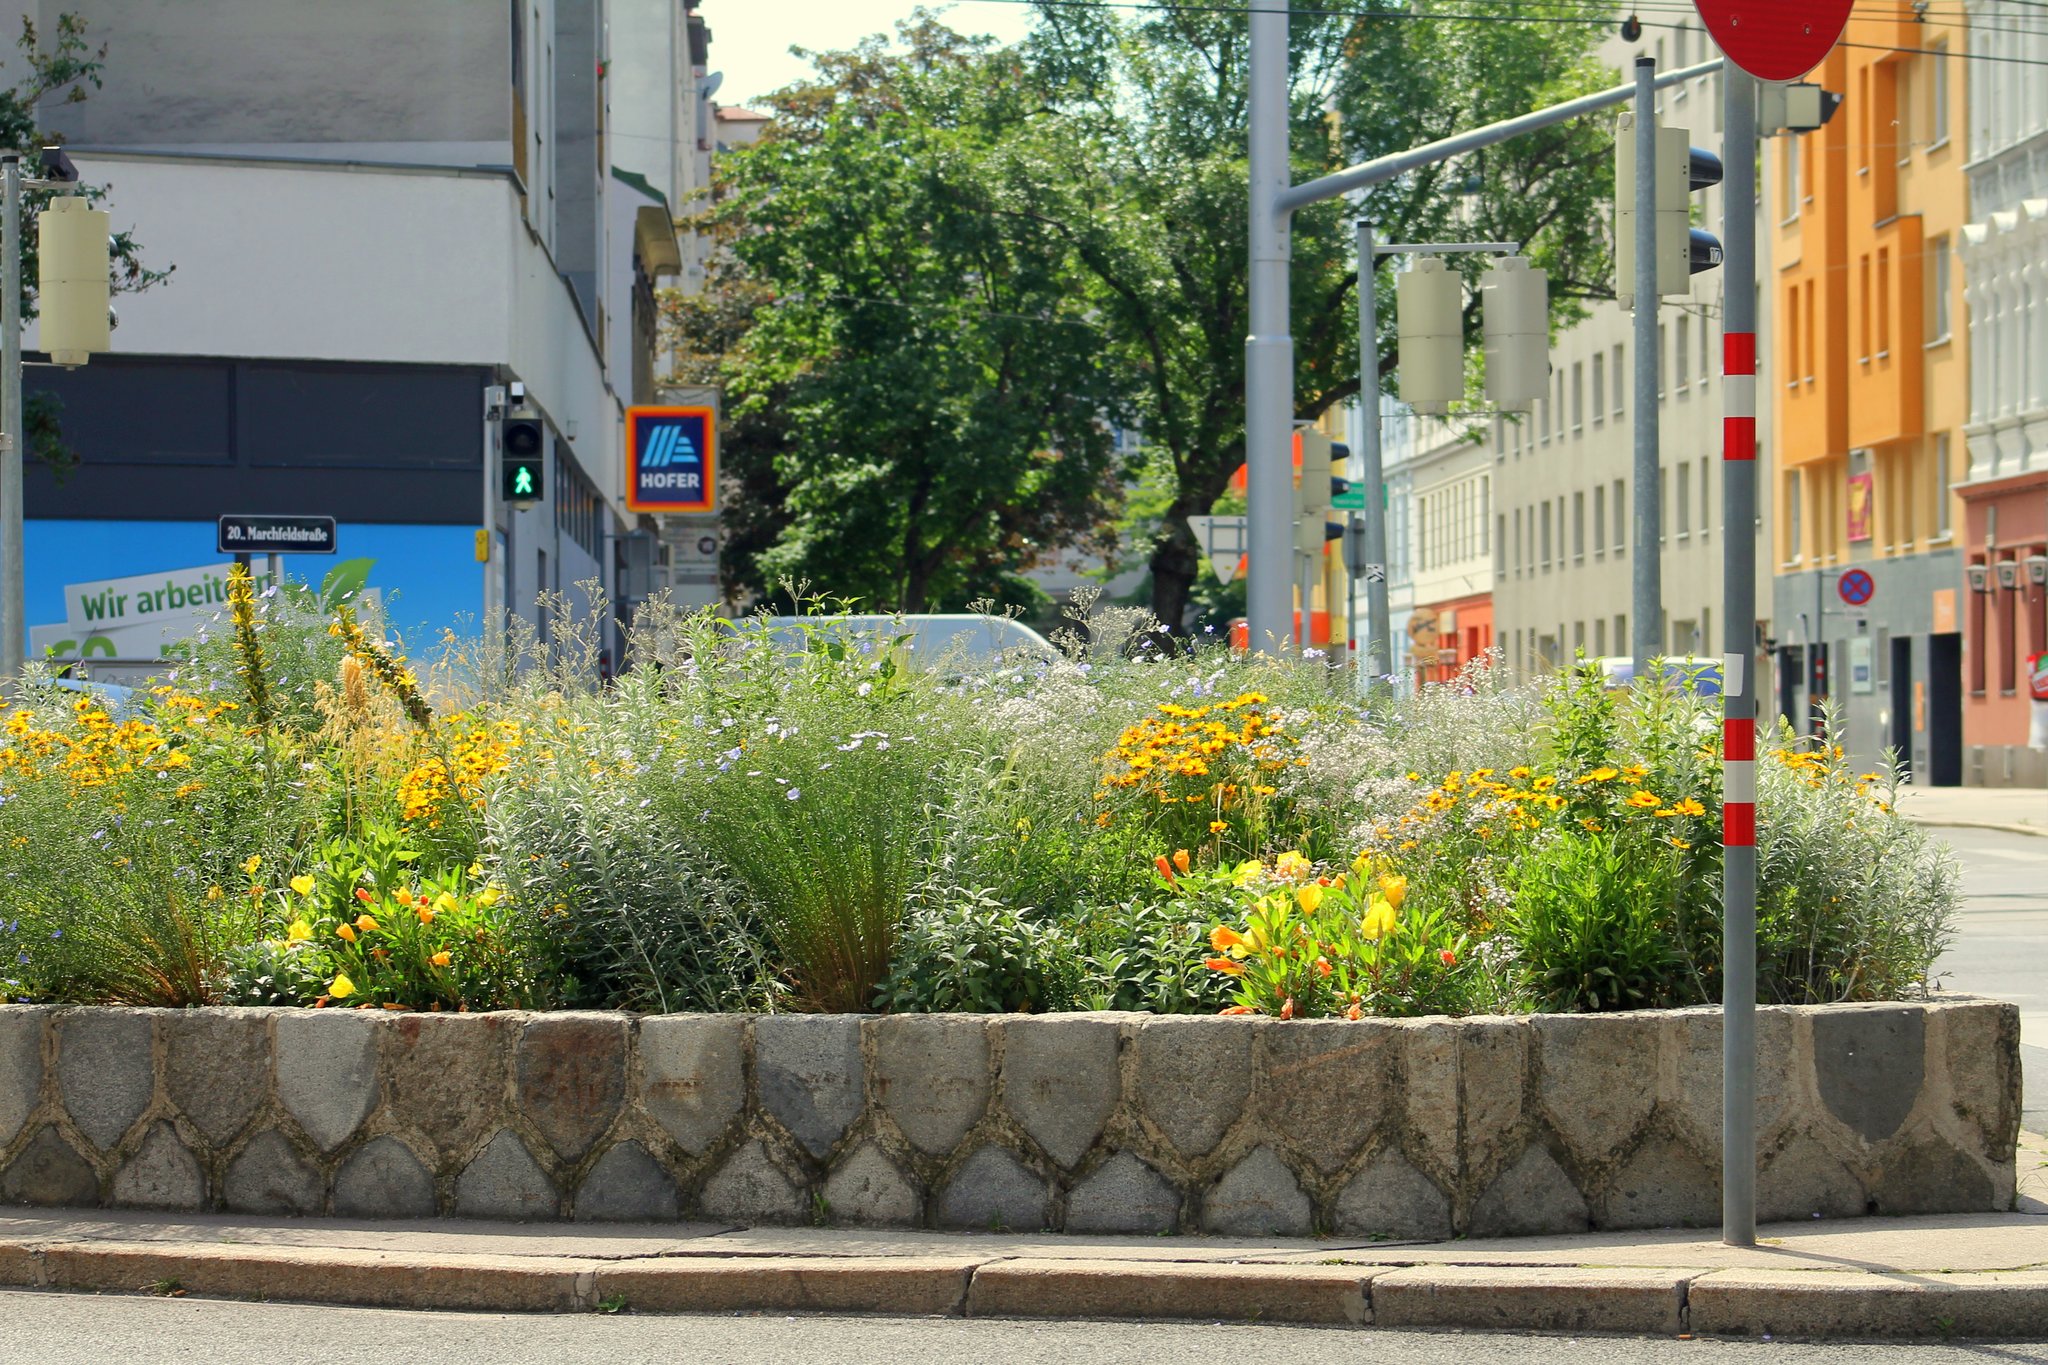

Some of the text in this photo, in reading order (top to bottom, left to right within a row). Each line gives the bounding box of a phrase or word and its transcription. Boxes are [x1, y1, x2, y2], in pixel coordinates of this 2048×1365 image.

[641, 473, 700, 488] HOFER
[247, 526, 328, 542] Marchfeldstraße
[81, 586, 128, 621] Wir
